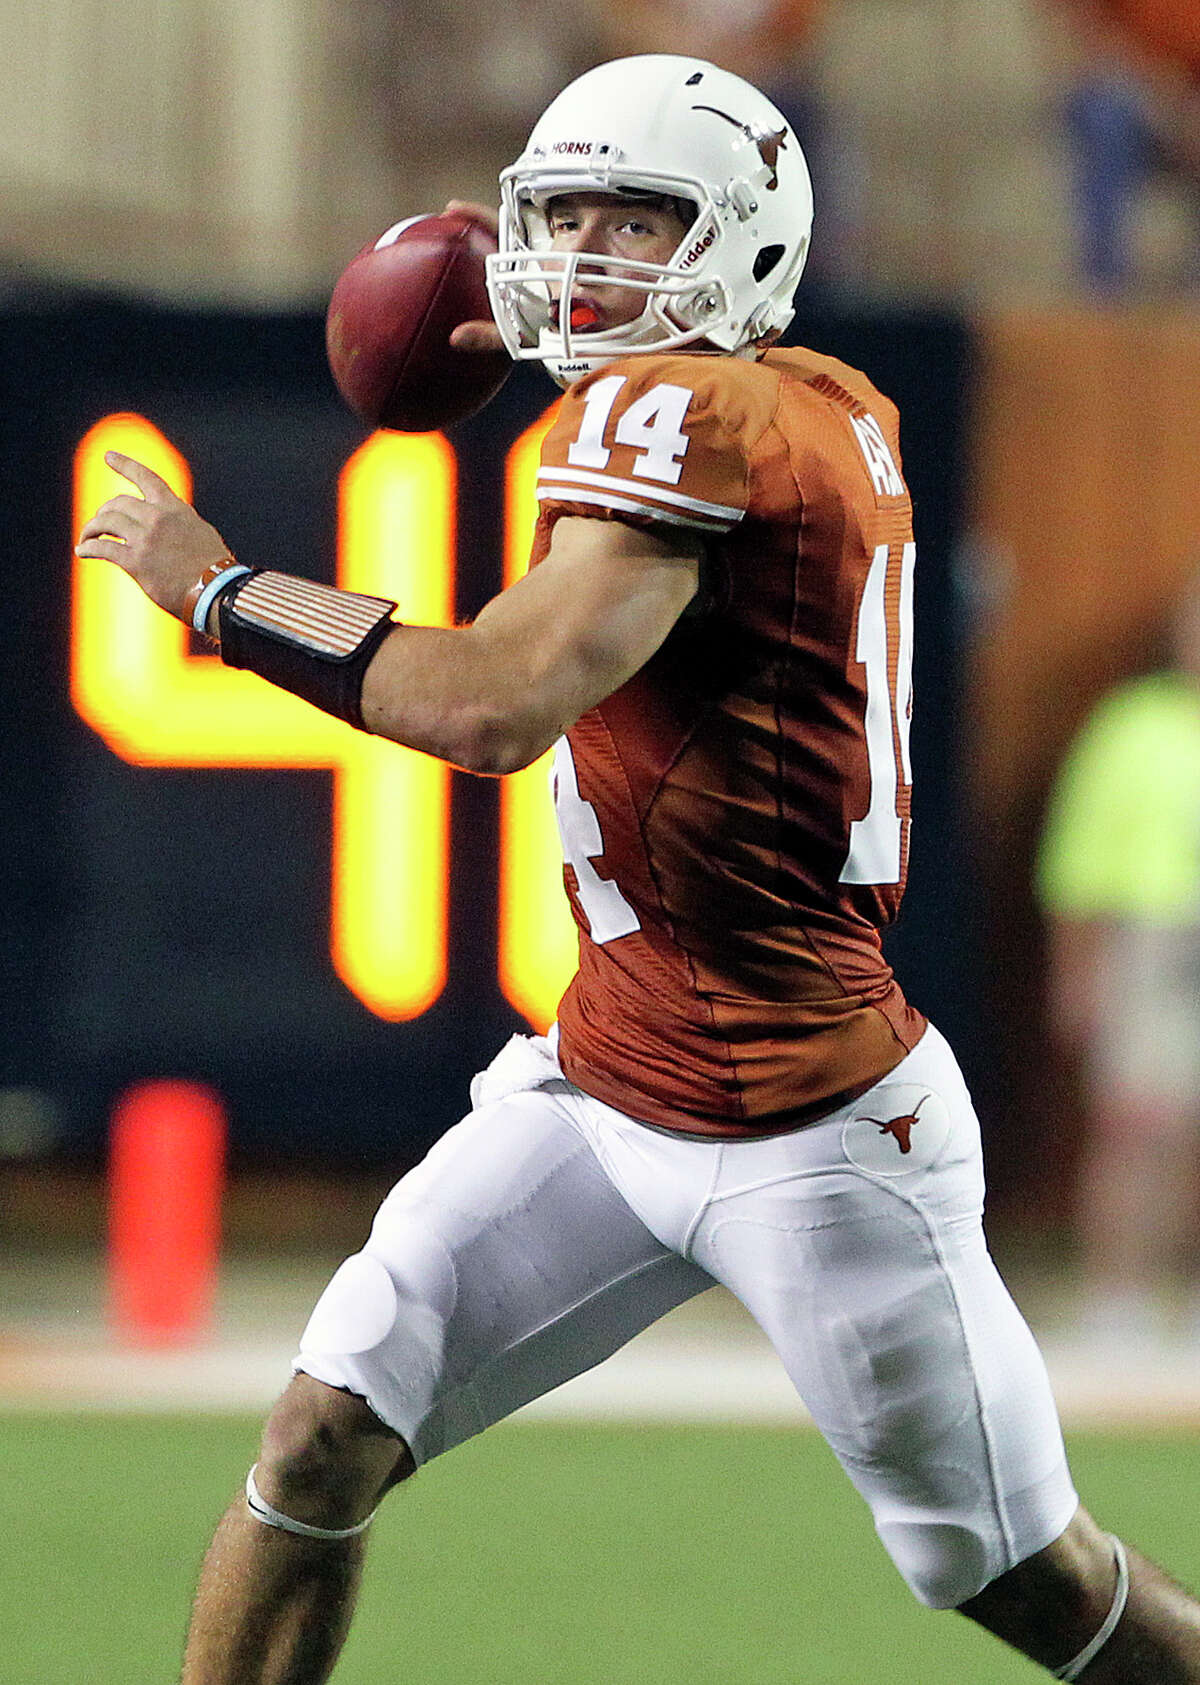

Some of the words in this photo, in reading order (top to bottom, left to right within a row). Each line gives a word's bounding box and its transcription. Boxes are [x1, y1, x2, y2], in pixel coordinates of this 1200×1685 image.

[552, 142, 593, 156] HORNS
[568, 375, 694, 485] 14
[549, 734, 642, 945] 4
